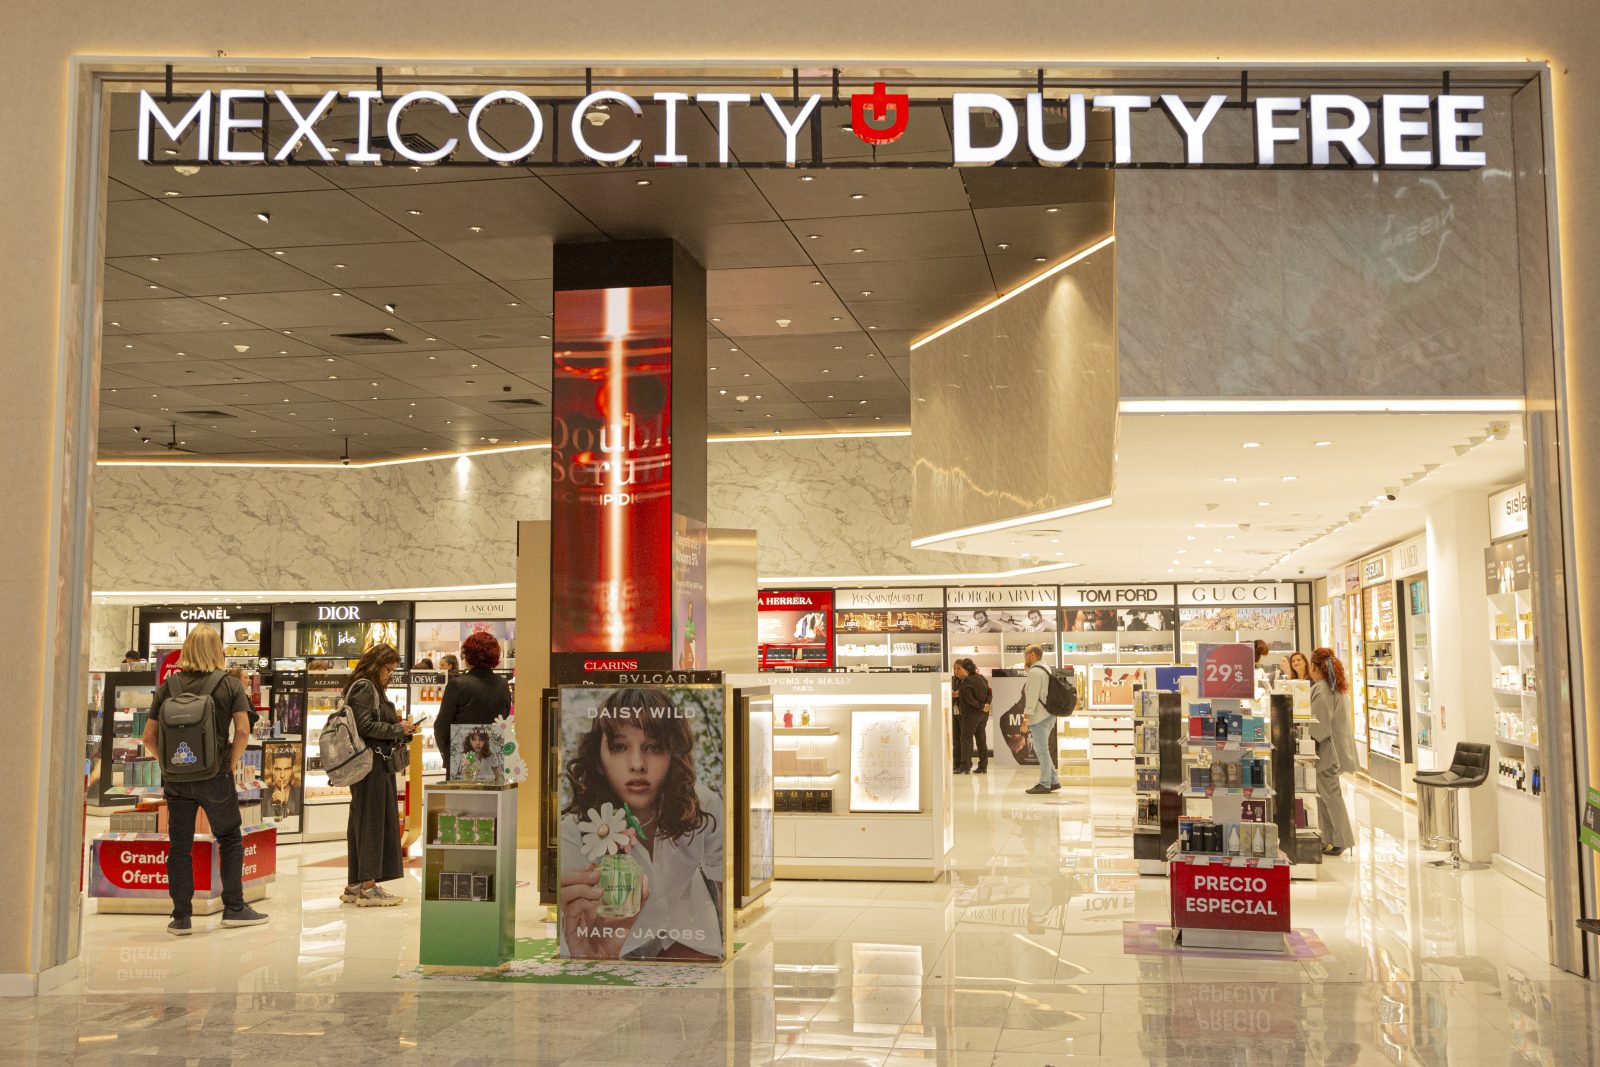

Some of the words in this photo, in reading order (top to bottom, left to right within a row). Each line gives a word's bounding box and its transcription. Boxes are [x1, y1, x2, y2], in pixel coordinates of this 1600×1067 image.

[137, 88, 544, 163] MEXICO
[571, 90, 821, 164] CITY
[952, 92, 1227, 166] DUTY
[1255, 93, 1487, 167] FREE
[553, 413, 671, 453] Doubl
[1506, 491, 1528, 515] sisle
[766, 596, 812, 606] HERRERA
[947, 589, 1002, 603] GIORGIO
[1008, 588, 1056, 603] ARMANI
[1077, 589, 1111, 603] TOM
[1116, 589, 1158, 602] FORD
[1192, 586, 1278, 602] GUCCI
[180, 609, 230, 620] CHANEL
[318, 606, 361, 620] DIOR
[584, 660, 639, 671] CLARINS
[1206, 663, 1232, 682] 29
[392, 675, 403, 684] EWE
[411, 675, 437, 684] LOEWE
[619, 673, 696, 684] BVLGARI
[818, 677, 851, 685] MARLY
[587, 706, 643, 719] DAISY
[649, 706, 697, 719] WILD
[120, 850, 169, 864] Grand
[244, 843, 257, 857] eat
[122, 869, 169, 884] Oferta
[1194, 875, 1267, 893] PRECIO
[1186, 897, 1278, 916] ESPECIAL
[576, 927, 626, 939] MARC
[632, 928, 706, 941] JACOBS
